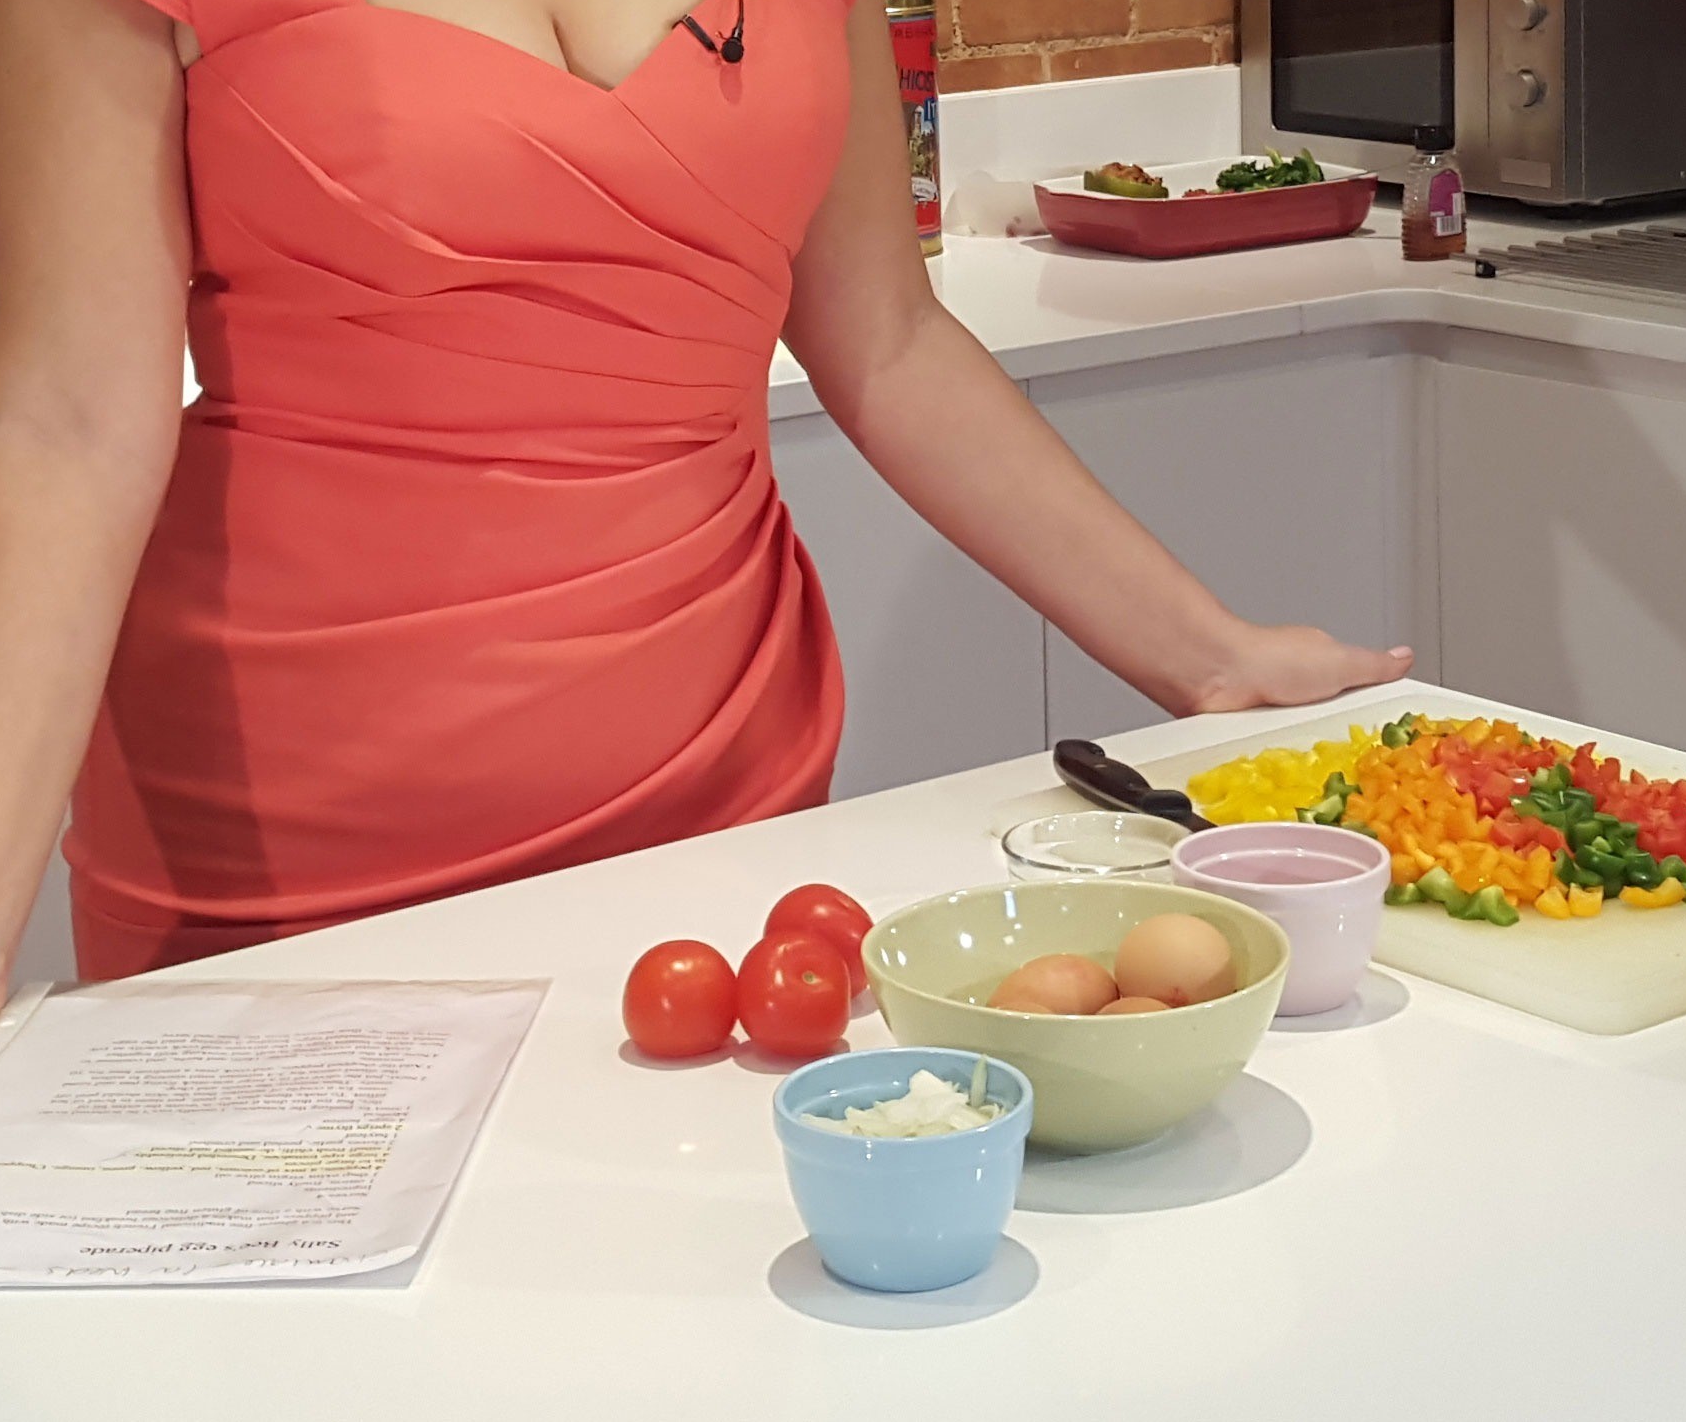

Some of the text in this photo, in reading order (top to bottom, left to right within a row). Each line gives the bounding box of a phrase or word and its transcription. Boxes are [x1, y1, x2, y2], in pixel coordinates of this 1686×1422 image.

[79, 1238, 341, 1255] Sally Bee's egg piperade
